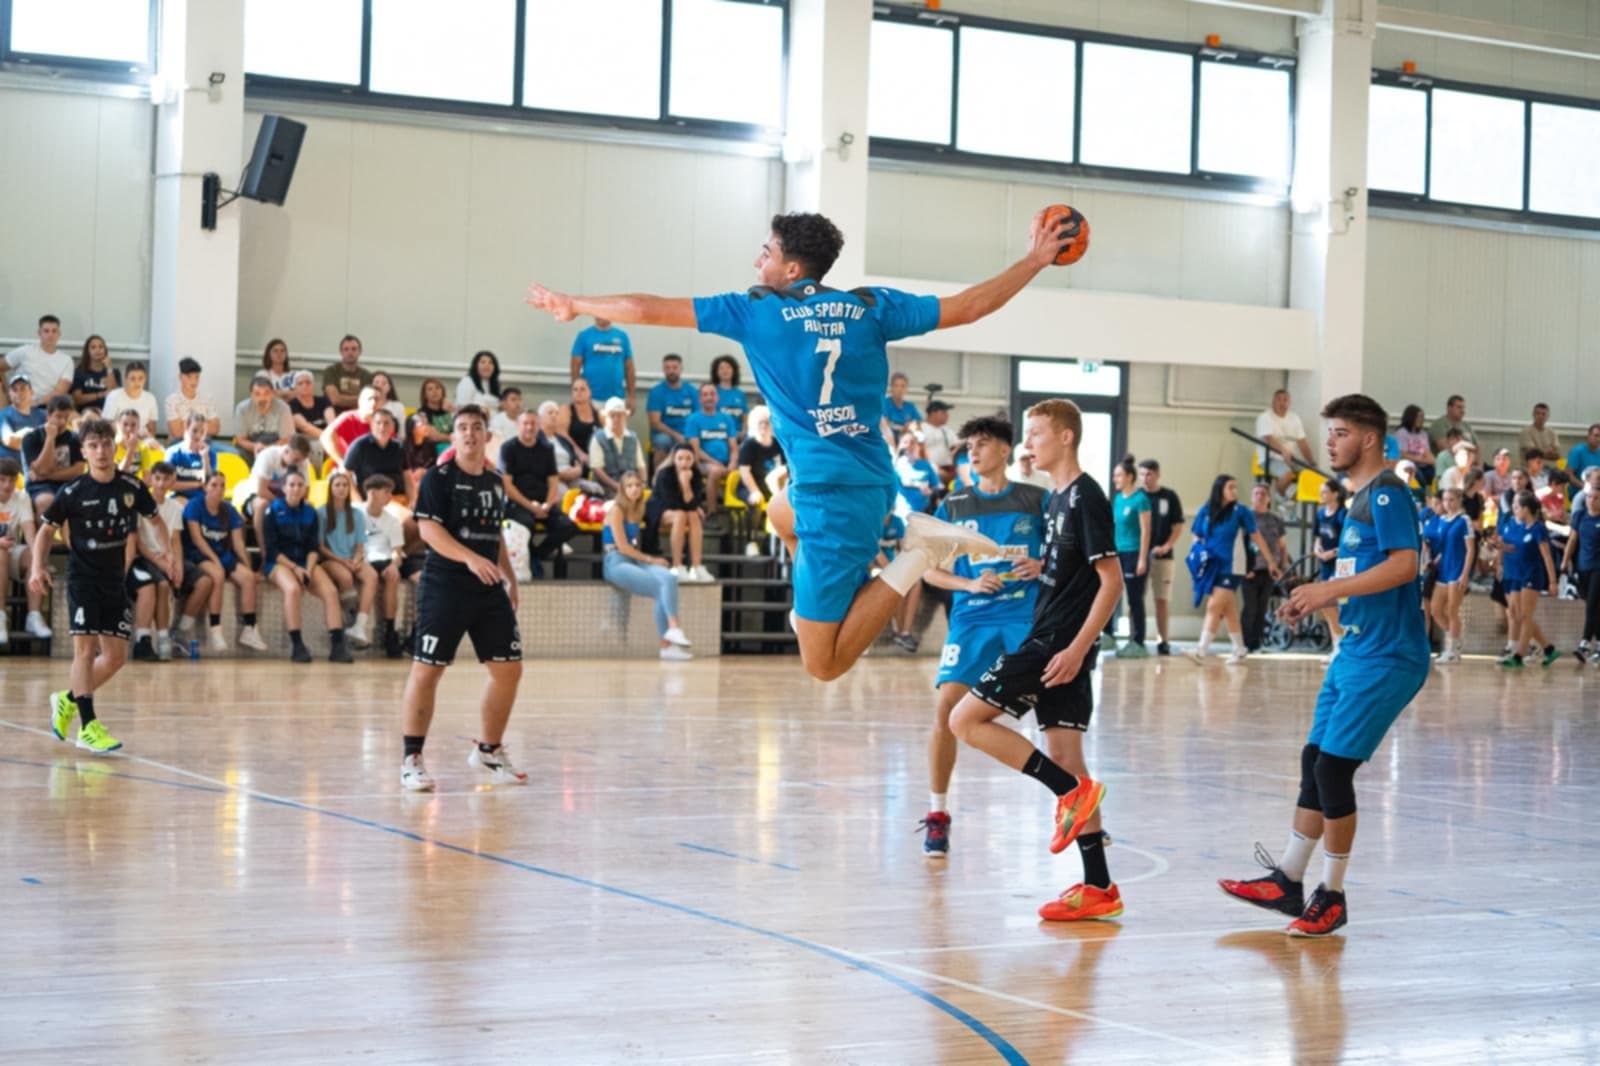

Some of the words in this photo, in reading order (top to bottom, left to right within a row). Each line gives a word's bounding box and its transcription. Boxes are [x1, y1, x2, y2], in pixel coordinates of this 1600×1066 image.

[781, 305, 815, 322] CLUB
[814, 302, 866, 320] SPORTIV
[815, 338, 843, 406] 7
[107, 498, 119, 516] 4
[74, 606, 86, 626] 4
[421, 633, 439, 655] 17
